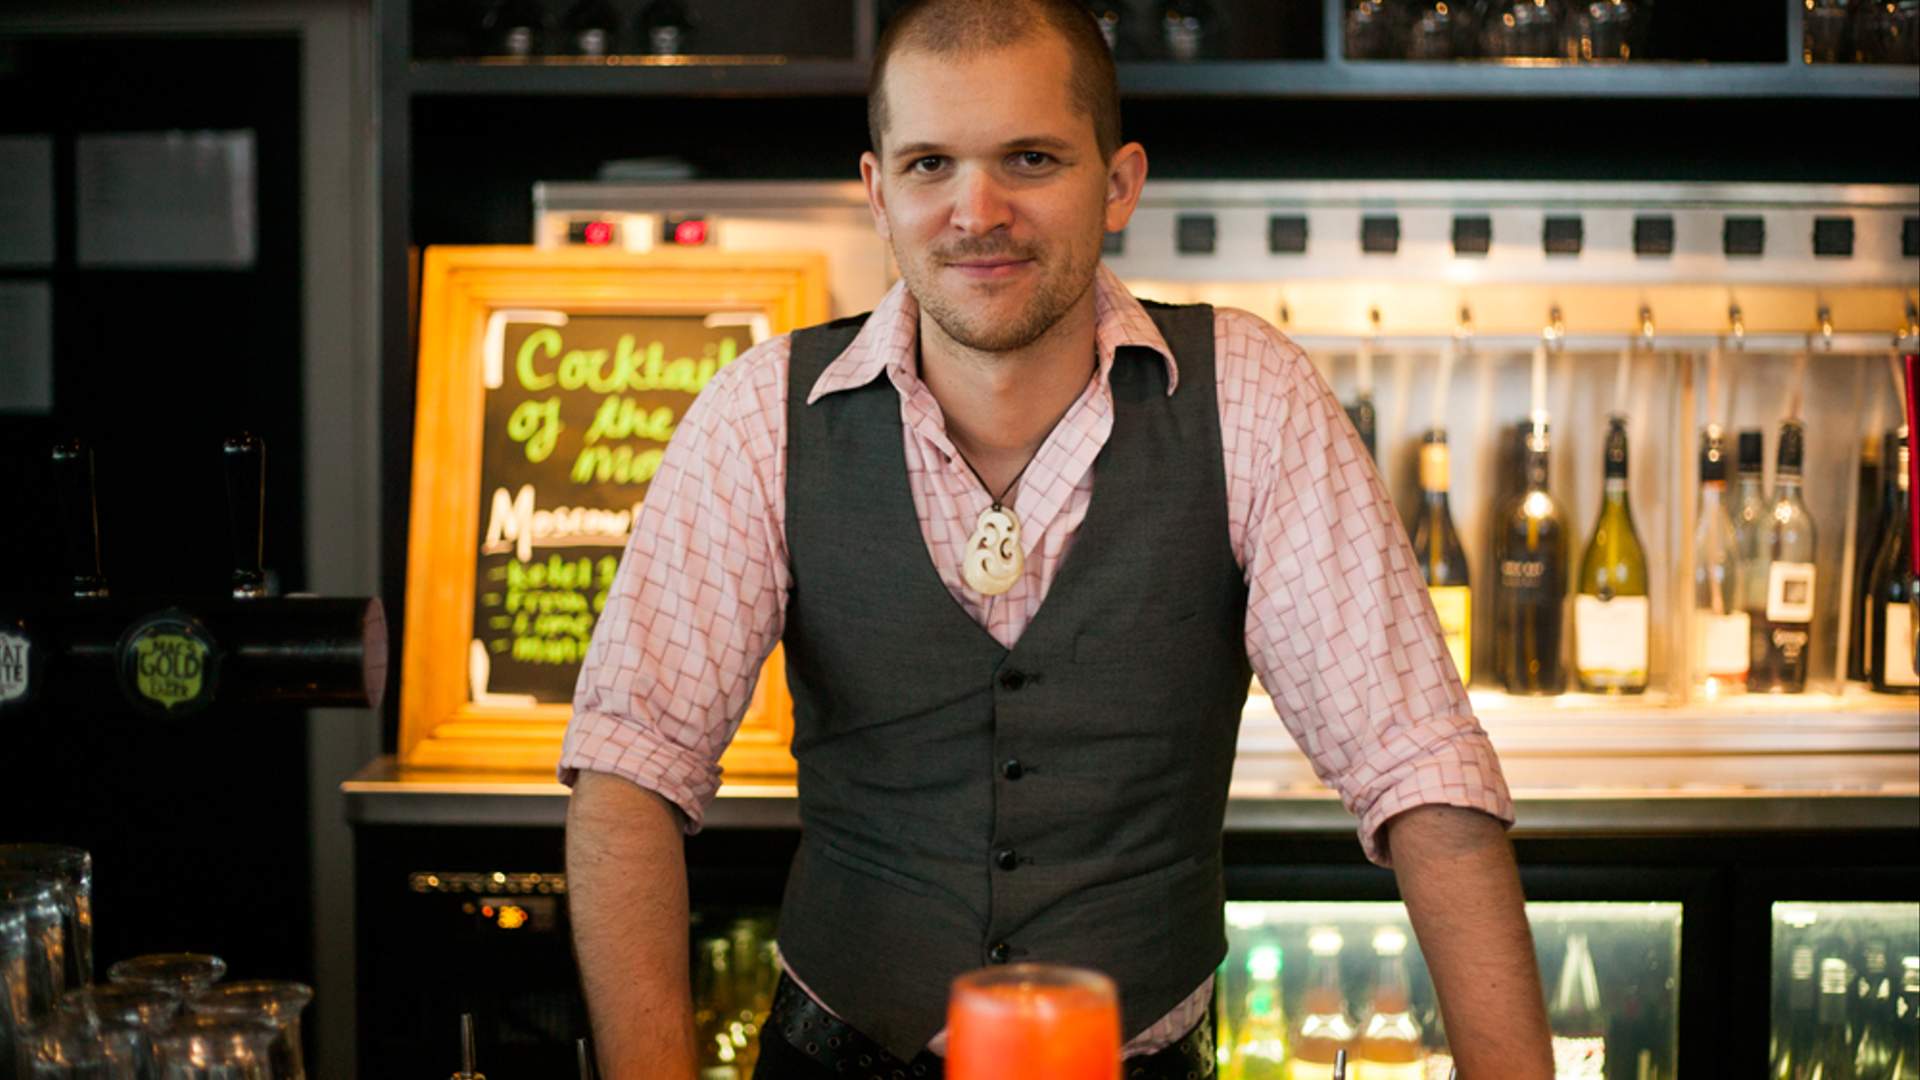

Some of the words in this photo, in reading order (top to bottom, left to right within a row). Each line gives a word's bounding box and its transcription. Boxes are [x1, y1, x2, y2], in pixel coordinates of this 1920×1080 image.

[507, 395, 565, 463] of
[584, 395, 674, 443] the
[139, 651, 200, 679] GOLD
